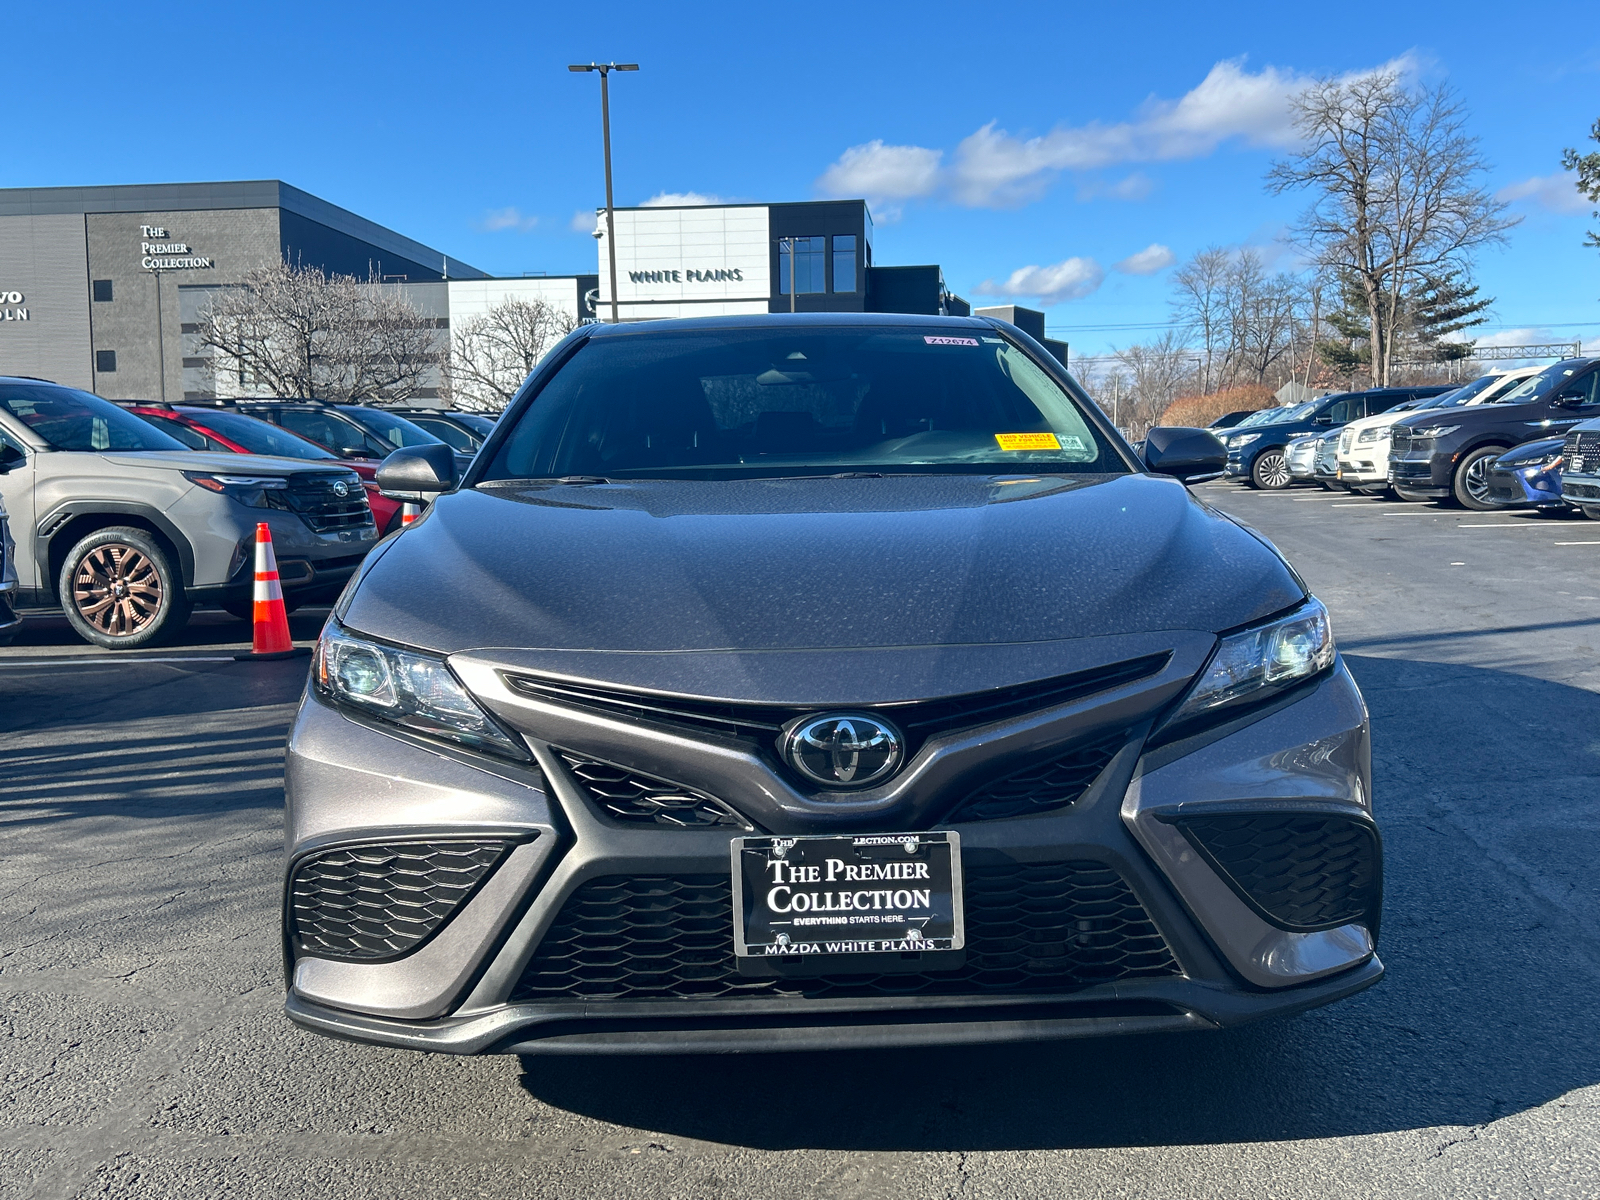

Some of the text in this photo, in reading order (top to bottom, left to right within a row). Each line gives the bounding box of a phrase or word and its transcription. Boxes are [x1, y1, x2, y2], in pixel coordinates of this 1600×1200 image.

[140, 225, 165, 238] THE
[141, 242, 188, 255] PREMIER
[142, 256, 210, 269] COLLECTION
[629, 268, 743, 283] WHITE PLAINS
[770, 835, 920, 847] THE LECTION.COM
[767, 858, 931, 884] THE PREMIER
[767, 885, 931, 913] COLLECTION
[793, 915, 906, 926] EVERYTHING STARTS HERE.
[765, 940, 935, 955] MAZDA WHITE PLAINS
